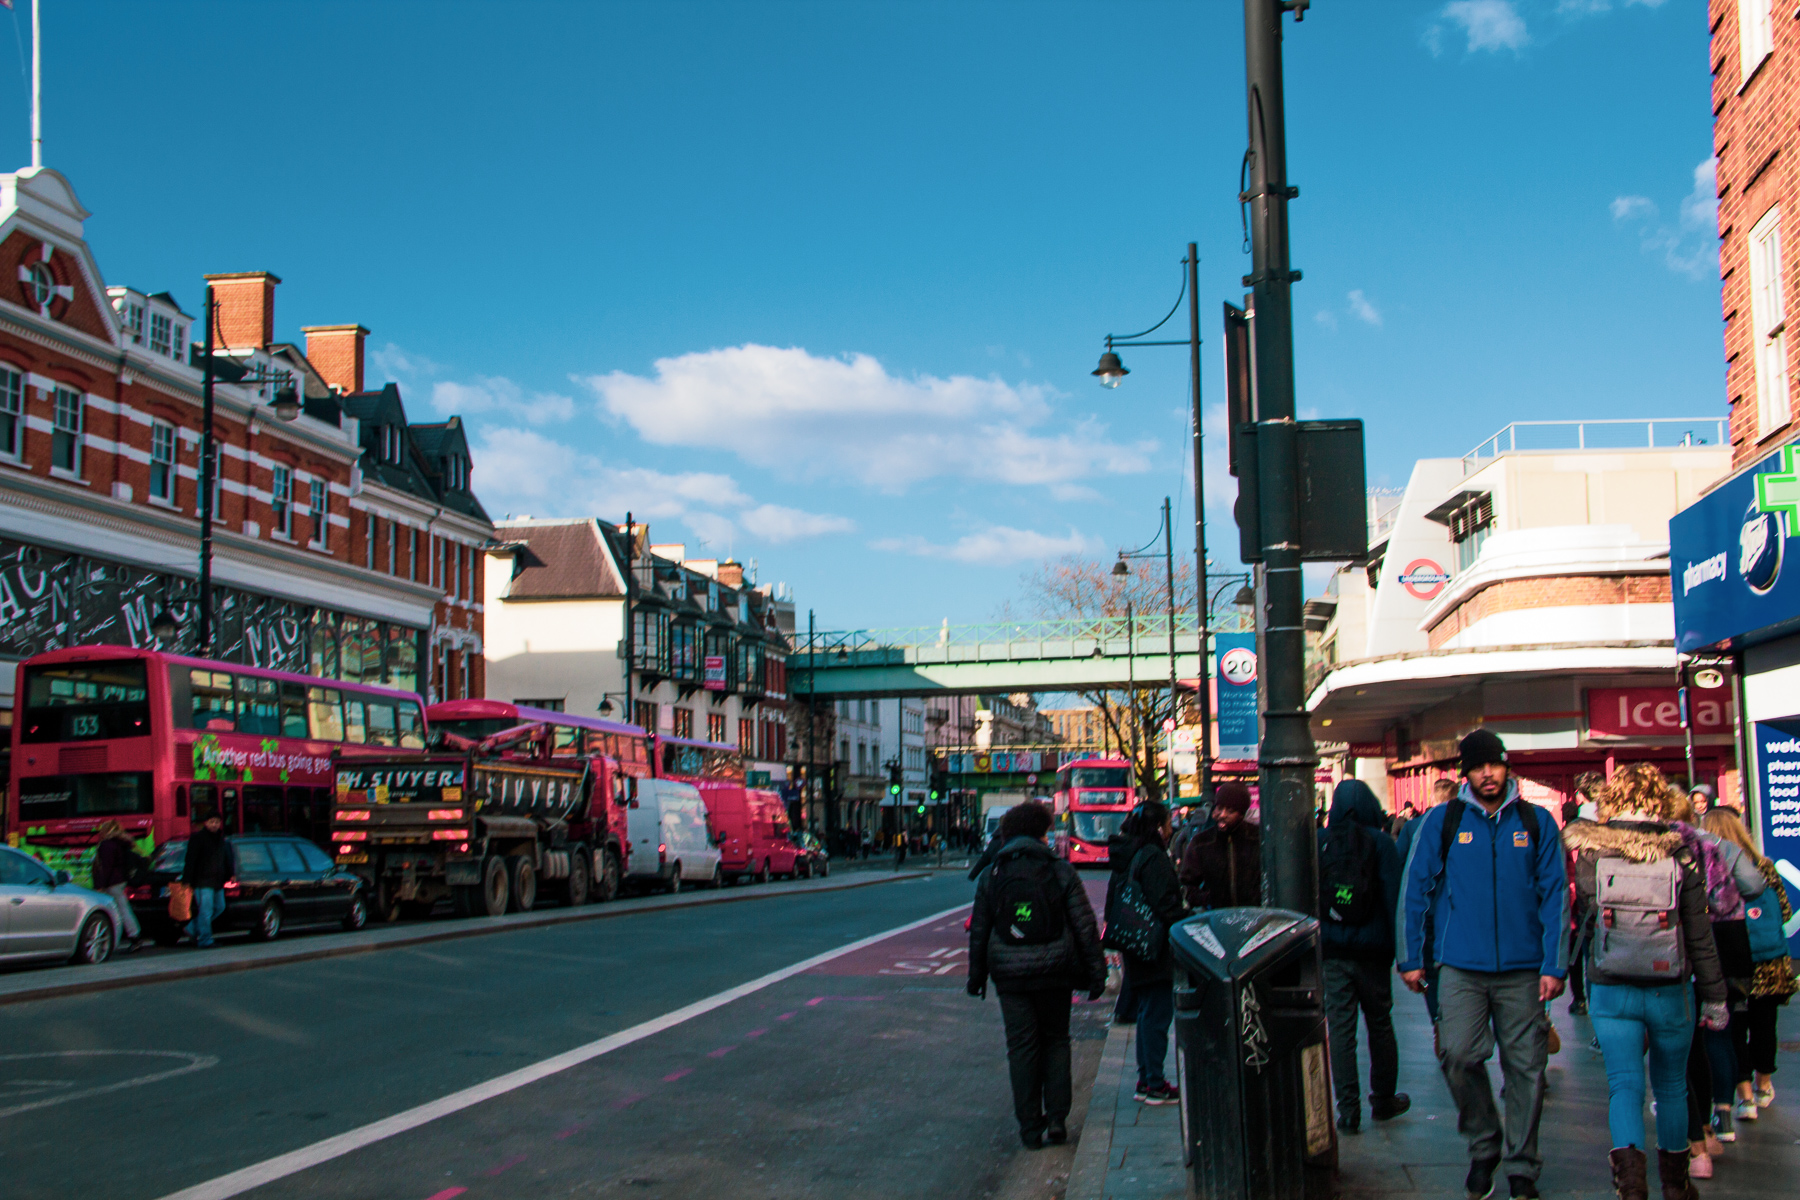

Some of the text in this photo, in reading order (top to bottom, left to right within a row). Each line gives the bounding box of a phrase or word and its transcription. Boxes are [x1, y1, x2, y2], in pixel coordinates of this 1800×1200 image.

[1682, 551, 1727, 597] pharmacy
[1227, 660, 1252, 675] 20
[73, 713, 100, 736] 133
[202, 745, 248, 766] Another
[249, 750, 267, 767] red
[268, 750, 287, 768] bus
[287, 752, 313, 774] going
[483, 776, 571, 809] SIVYER
[1768, 785, 1799, 798] food
[1770, 799, 1800, 812] baby
[1772, 825, 1800, 838] elec
